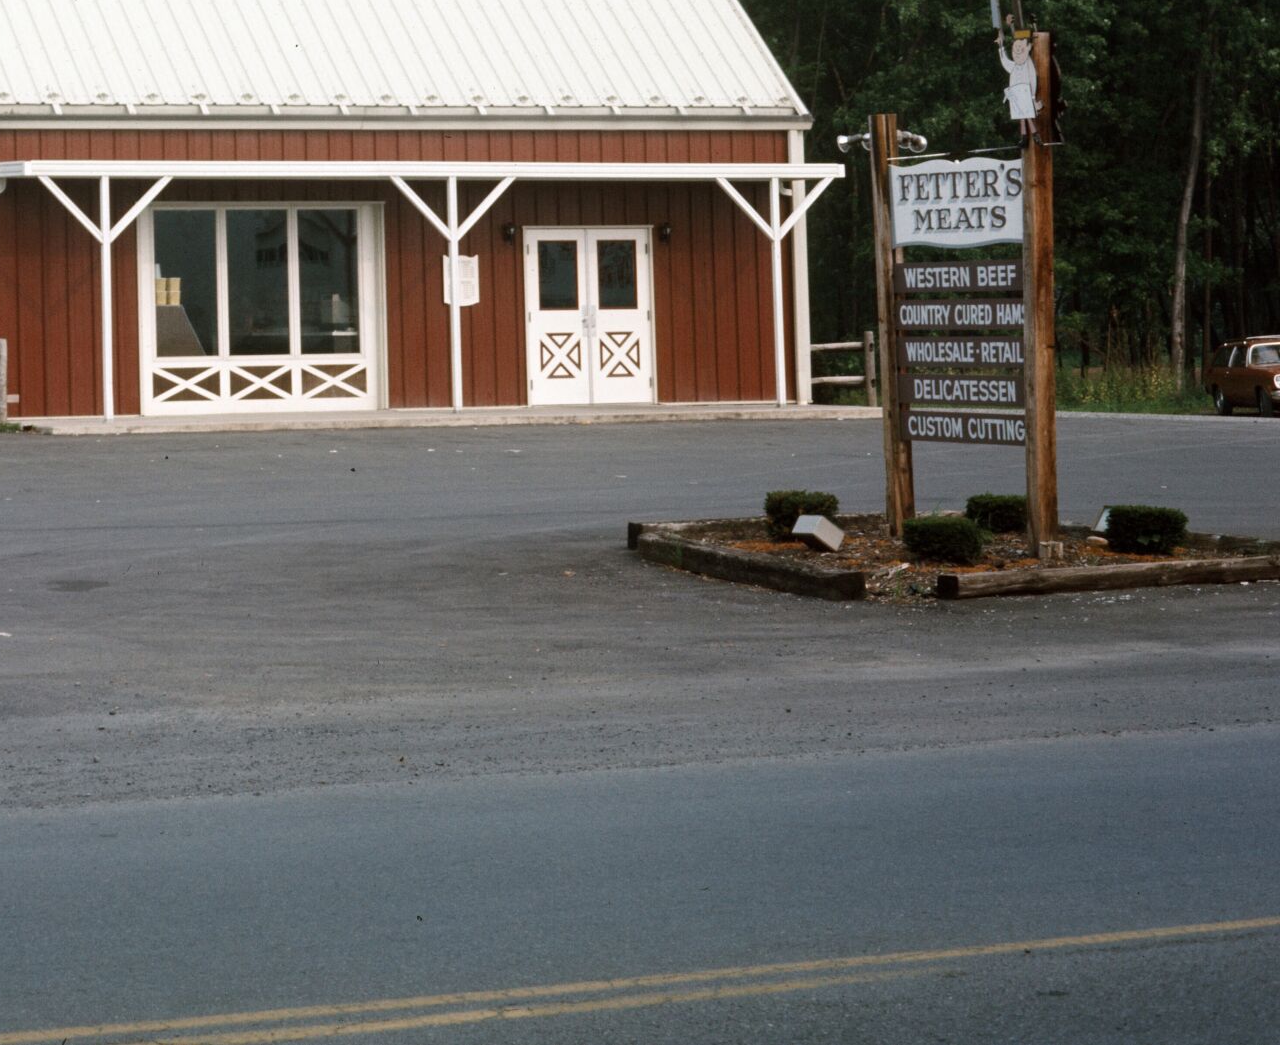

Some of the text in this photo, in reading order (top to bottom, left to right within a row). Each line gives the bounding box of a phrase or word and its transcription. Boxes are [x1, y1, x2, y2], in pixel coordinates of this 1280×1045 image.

[898, 163, 1023, 202] FETTER'S
[913, 205, 1007, 231] MEATS
[904, 265, 1016, 288] WESTERN BEEF
[900, 304, 951, 325] COUNTRY
[954, 304, 992, 325] CURED
[914, 379, 1016, 402] DELICATESSEN
[908, 416, 1025, 441] CUSTOM CUTTING
